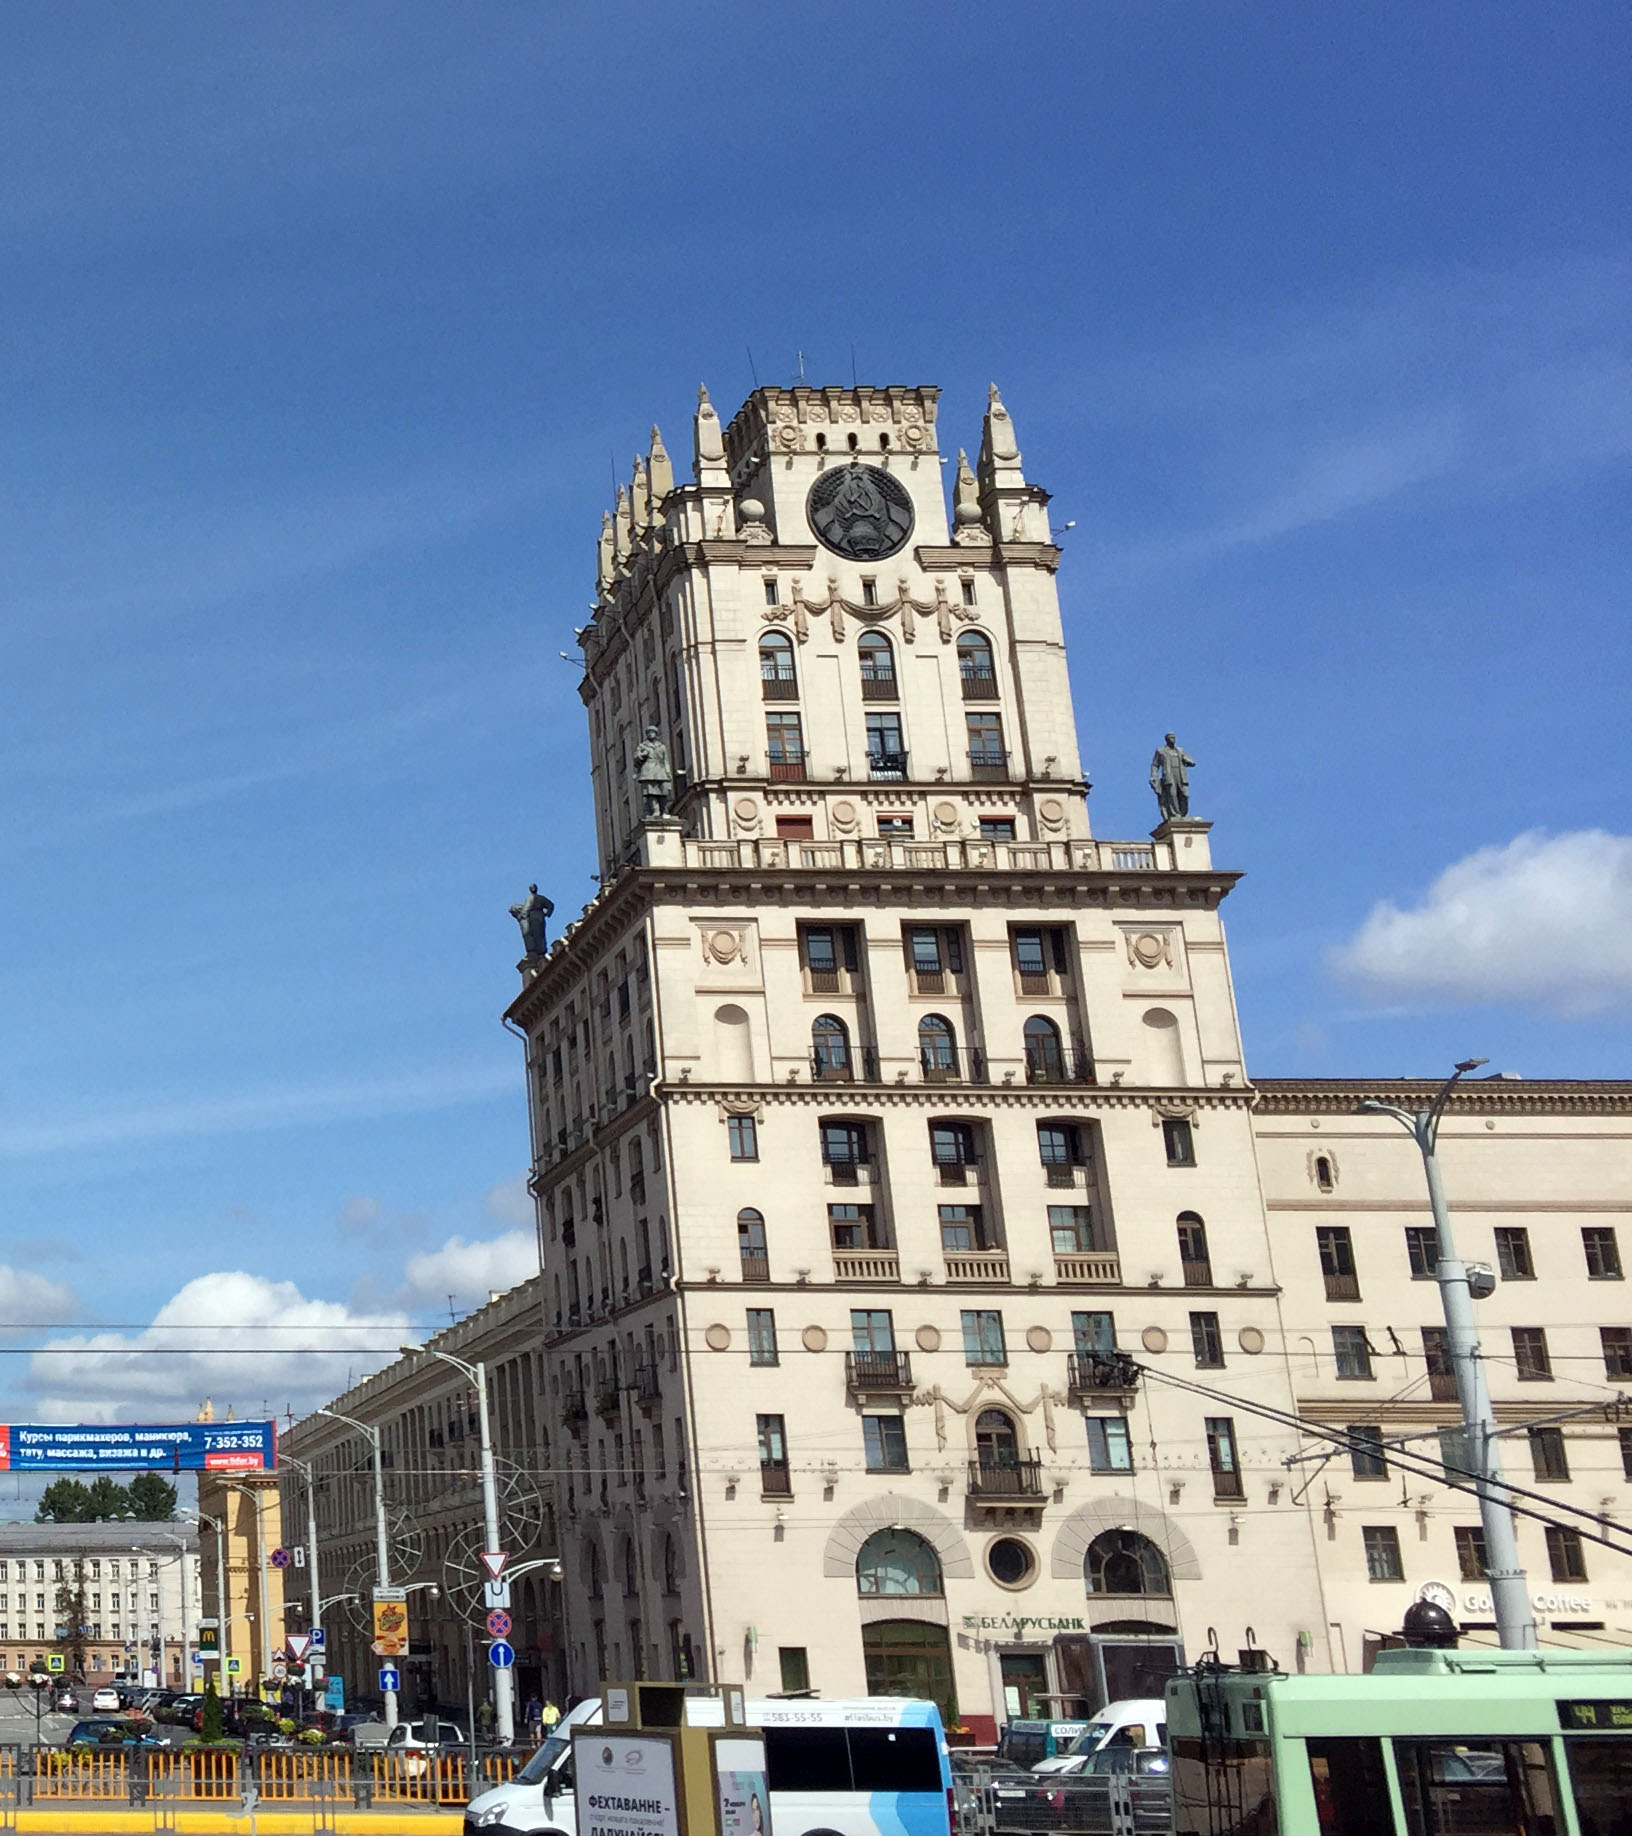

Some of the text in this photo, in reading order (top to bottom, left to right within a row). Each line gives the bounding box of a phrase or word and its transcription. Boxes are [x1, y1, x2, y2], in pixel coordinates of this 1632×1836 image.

[19, 1431, 53, 1444] Курсы
[55, 1432, 133, 1445] парикмахеров,
[135, 1431, 193, 1444] маникюра,
[204, 1435, 263, 1449] 7-352-352
[19, 1447, 167, 1459] тату, массажа, визажа и др.
[1533, 1594, 1592, 1613] Coffee
[981, 1616, 1086, 1630] БЕЛАРУСБАНК
[772, 1712, 823, 1722] 583-55-55
[1574, 1705, 1597, 1724] 44
[588, 1795, 662, 1814] ФЕХТАВАННЕ
